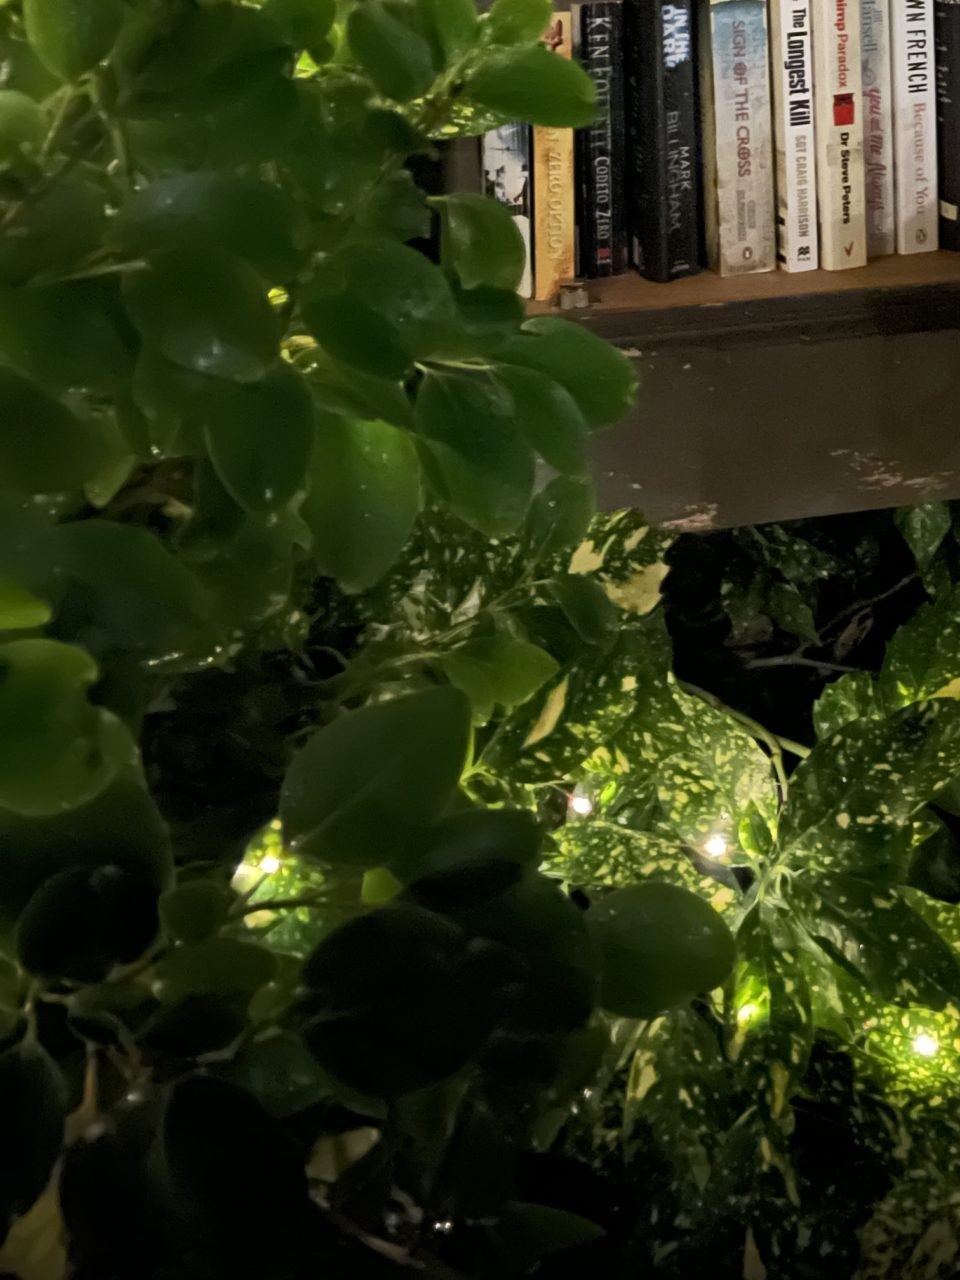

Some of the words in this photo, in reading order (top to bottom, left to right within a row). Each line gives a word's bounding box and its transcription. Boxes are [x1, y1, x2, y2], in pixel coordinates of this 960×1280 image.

[586, 16, 612, 58] KEN
[792, 8, 806, 28] The
[732, 21, 747, 58] SIGN
[784, 32, 809, 96] Longest
[836, 34, 850, 88] Paradox
[906, 29, 928, 94] FRENCH
[735, 88, 750, 120] THE
[789, 100, 810, 126] Kill
[736, 126, 752, 177] CROSS
[795, 135, 807, 154] SGT
[840, 132, 850, 146] Dr
[912, 102, 926, 162] Because
[548, 151, 562, 192] ZERO
[666, 111, 680, 234] BILLINGHAM
[679, 146, 690, 190] MARK
[796, 156, 808, 186] CRAIG
[841, 150, 852, 184] Steve
[914, 166, 928, 182] of
[797, 188, 810, 238] HARRISON
[842, 186, 852, 224] Peters
[914, 186, 928, 214] You
[548, 199, 563, 260] OPTION
